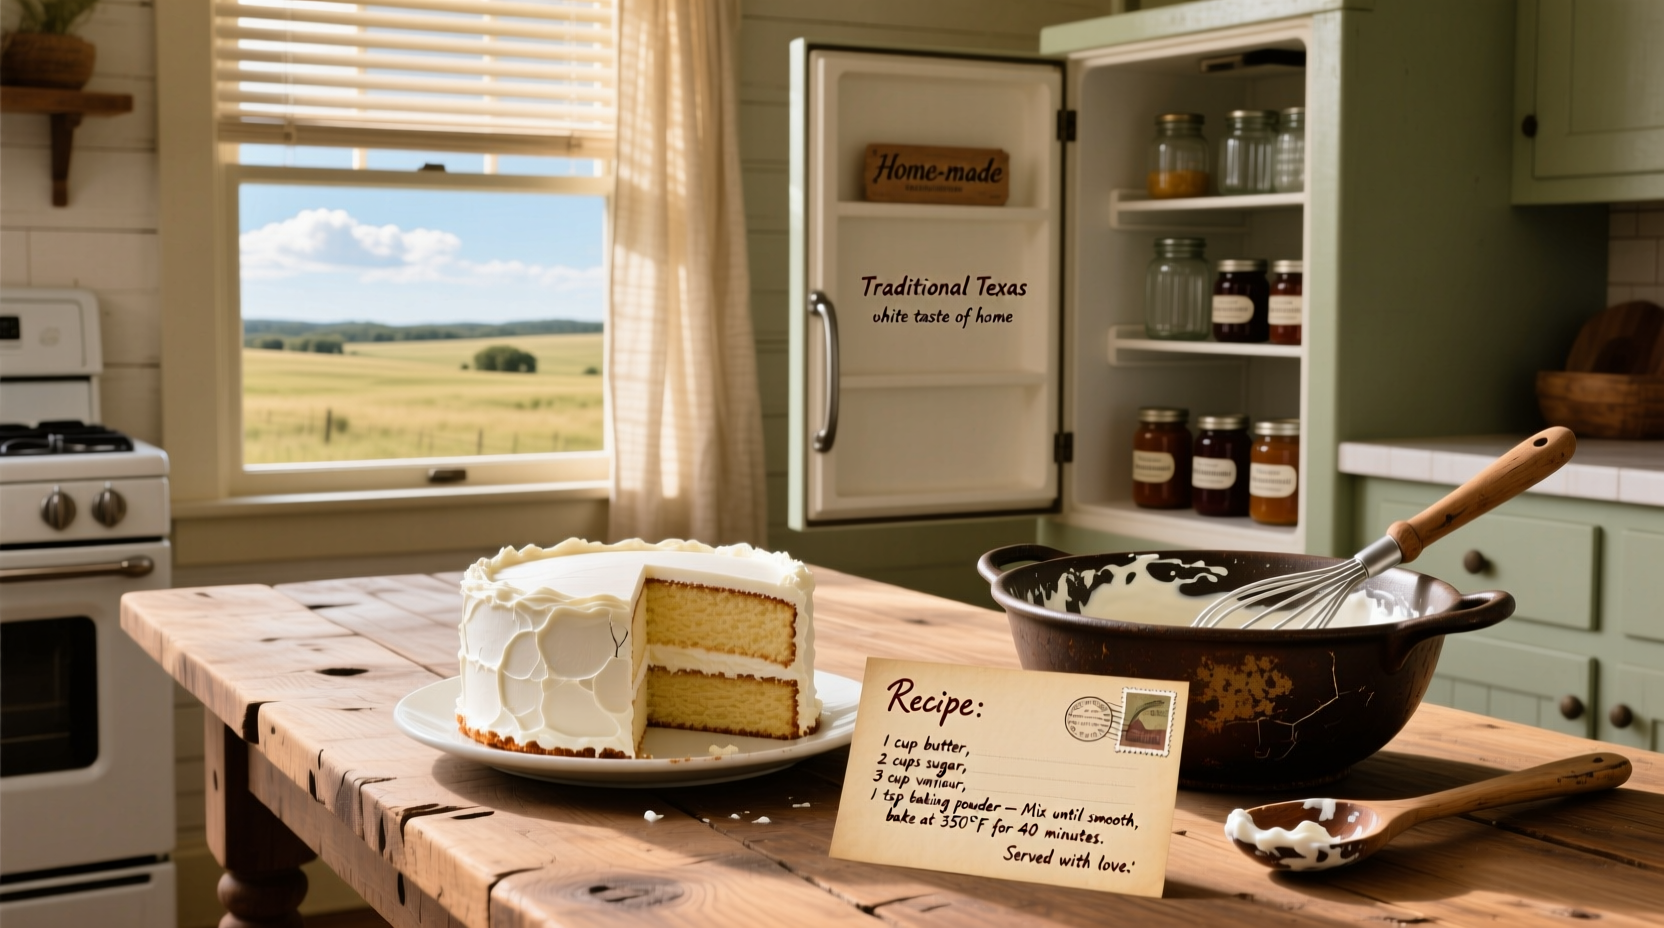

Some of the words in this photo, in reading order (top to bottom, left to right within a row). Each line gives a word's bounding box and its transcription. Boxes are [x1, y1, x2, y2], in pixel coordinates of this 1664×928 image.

[873, 152, 1003, 184] Home-made
[861, 274, 970, 297] Traditional
[976, 275, 1027, 297] Texas
[914, 309, 950, 323] taste
[955, 307, 973, 329] of
[975, 306, 1013, 323] home
[886, 677, 984, 727] Recipe:
[894, 738, 918, 755] cup
[923, 735, 970, 758] butter,
[877, 753, 887, 765] 2
[892, 757, 921, 772] cups
[926, 756, 968, 778] sugar,
[873, 769, 883, 782] 3
[888, 774, 910, 789] cup
[883, 790, 904, 808] tsp
[909, 790, 950, 814] baking
[953, 797, 1002, 814] powder
[1021, 803, 1047, 818] Mix
[1053, 806, 1083, 822] until
[1087, 811, 1139, 831] smooth,
[886, 807, 916, 825] bake
[920, 813, 936, 826] at
[991, 819, 1014, 838] for
[1018, 823, 1038, 837] 40
[1045, 827, 1104, 845] minutes.
[1003, 845, 1054, 865] Served
[1059, 852, 1091, 869] with
